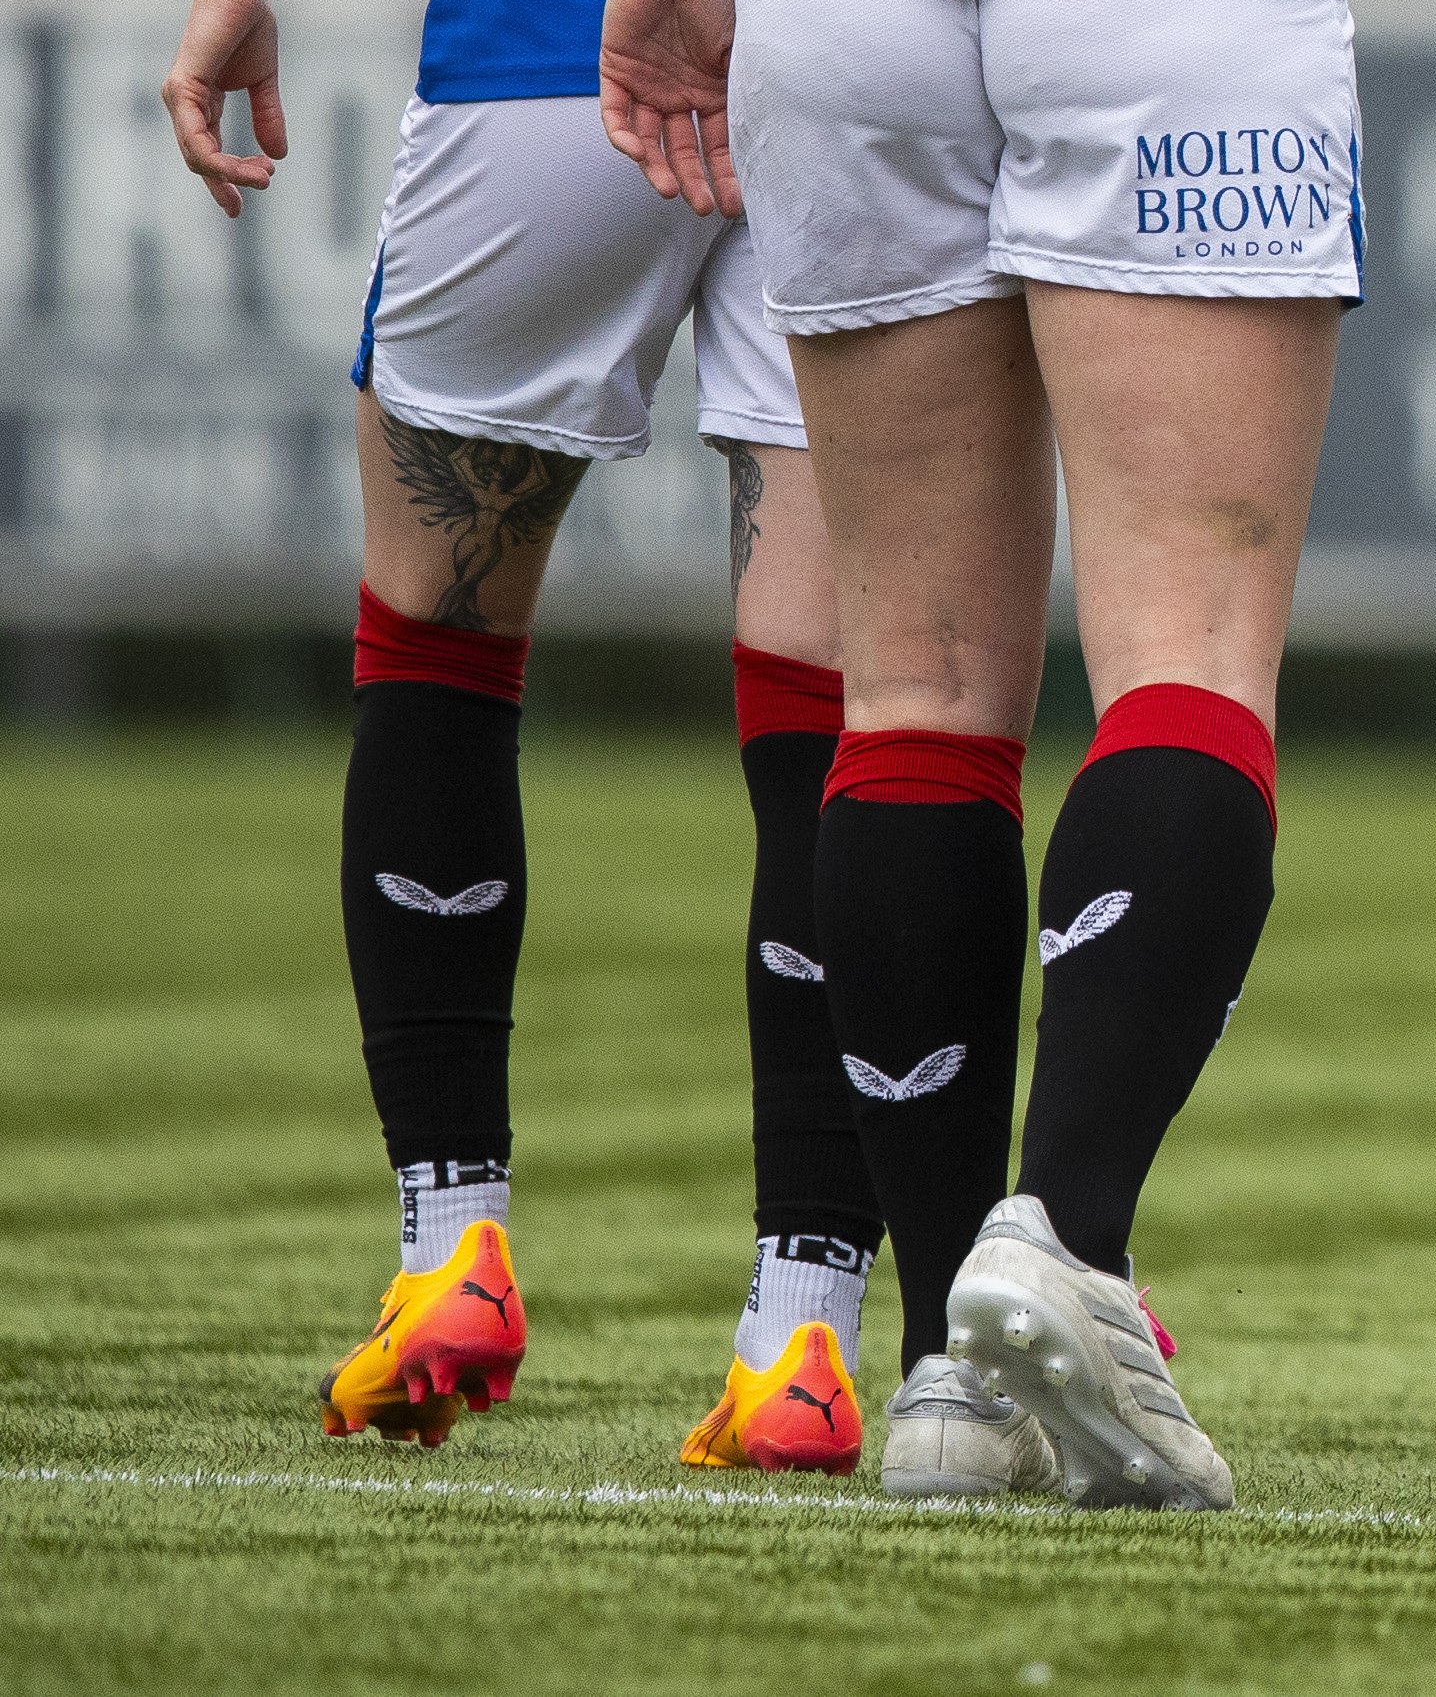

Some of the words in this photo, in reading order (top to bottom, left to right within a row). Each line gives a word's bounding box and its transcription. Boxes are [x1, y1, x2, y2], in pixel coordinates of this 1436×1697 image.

[1136, 127, 1331, 180] MOLTON
[1135, 183, 1331, 235] BROWN
[1175, 240, 1303, 258] LONDON
